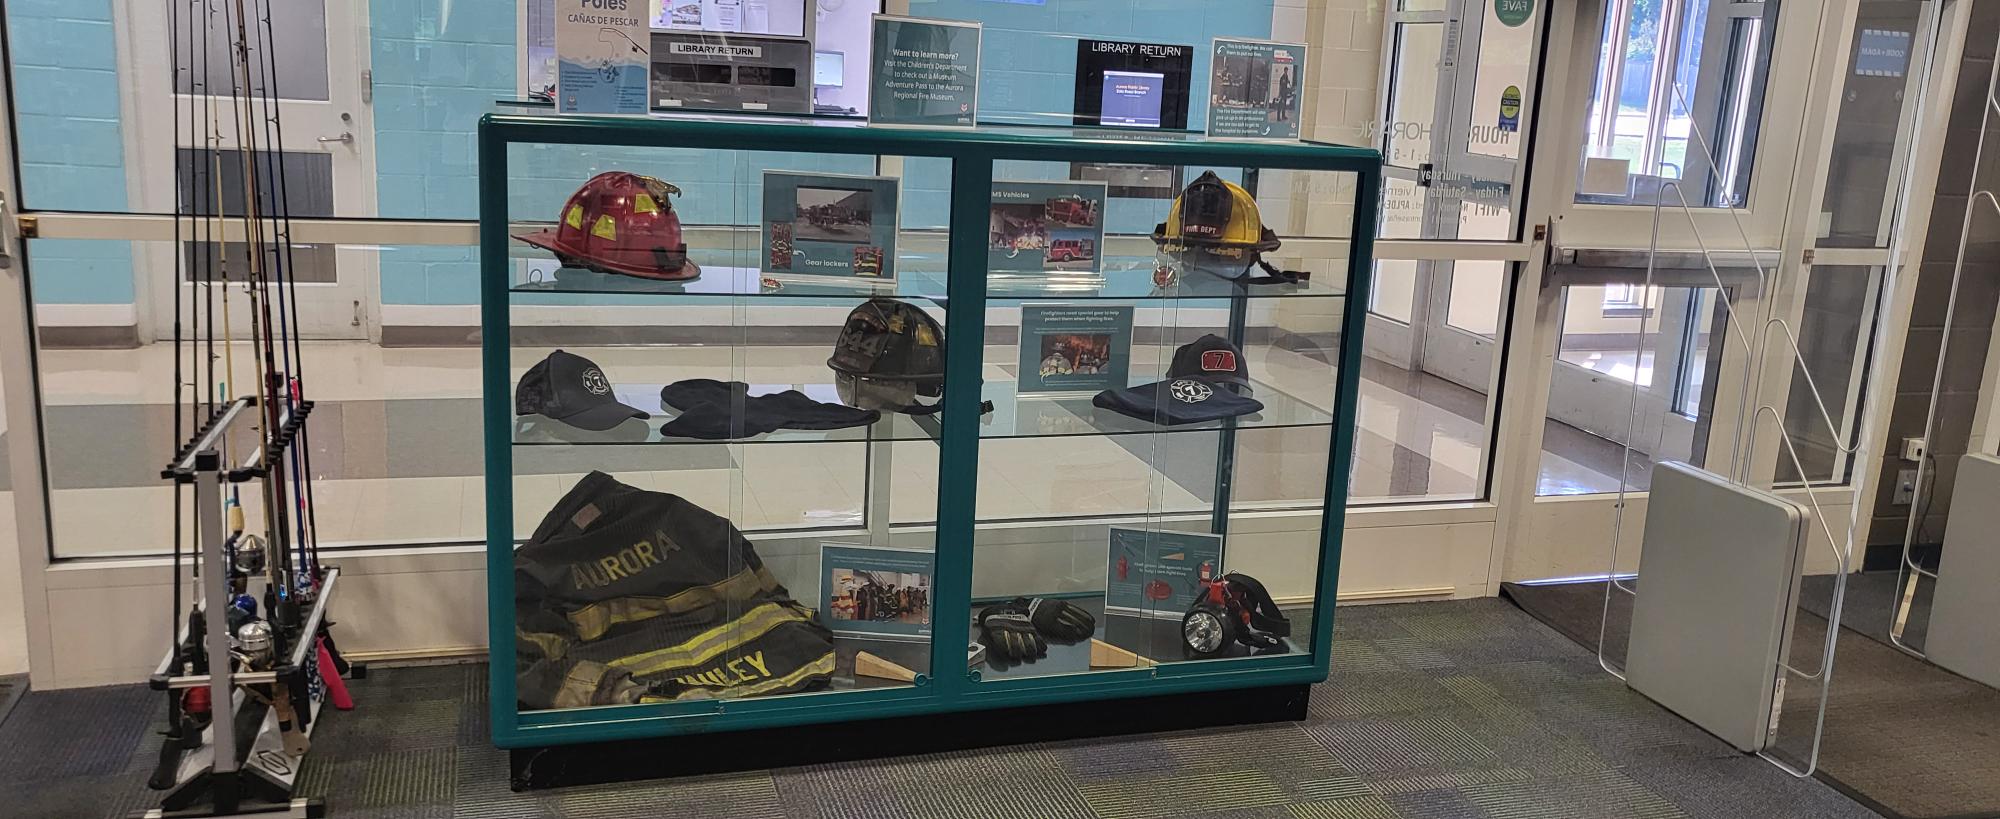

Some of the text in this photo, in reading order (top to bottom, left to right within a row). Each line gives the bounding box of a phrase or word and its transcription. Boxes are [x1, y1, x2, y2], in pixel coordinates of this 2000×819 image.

[567, 13, 639, 27] CAÑAS DE PESCAR
[677, 44, 754, 56] LIBRARY RETURN
[892, 49, 911, 57] Want
[912, 50, 919, 58] to
[920, 50, 938, 59] learn
[1092, 42, 1182, 57] LIBRARY RETURN
[907, 61, 935, 70] Children's
[935, 63, 968, 72] Department
[901, 71, 918, 79] check
[885, 80, 914, 89] Adventure
[915, 82, 928, 90] Pass
[945, 84, 964, 92] Aurora
[893, 91, 918, 100] Regional
[1200, 225, 1217, 235] DEPT
[805, 259, 849, 268] Gear lockers
[1214, 352, 1224, 368] 7
[1185, 386, 1196, 396] 7
[568, 529, 681, 591] AURORA
